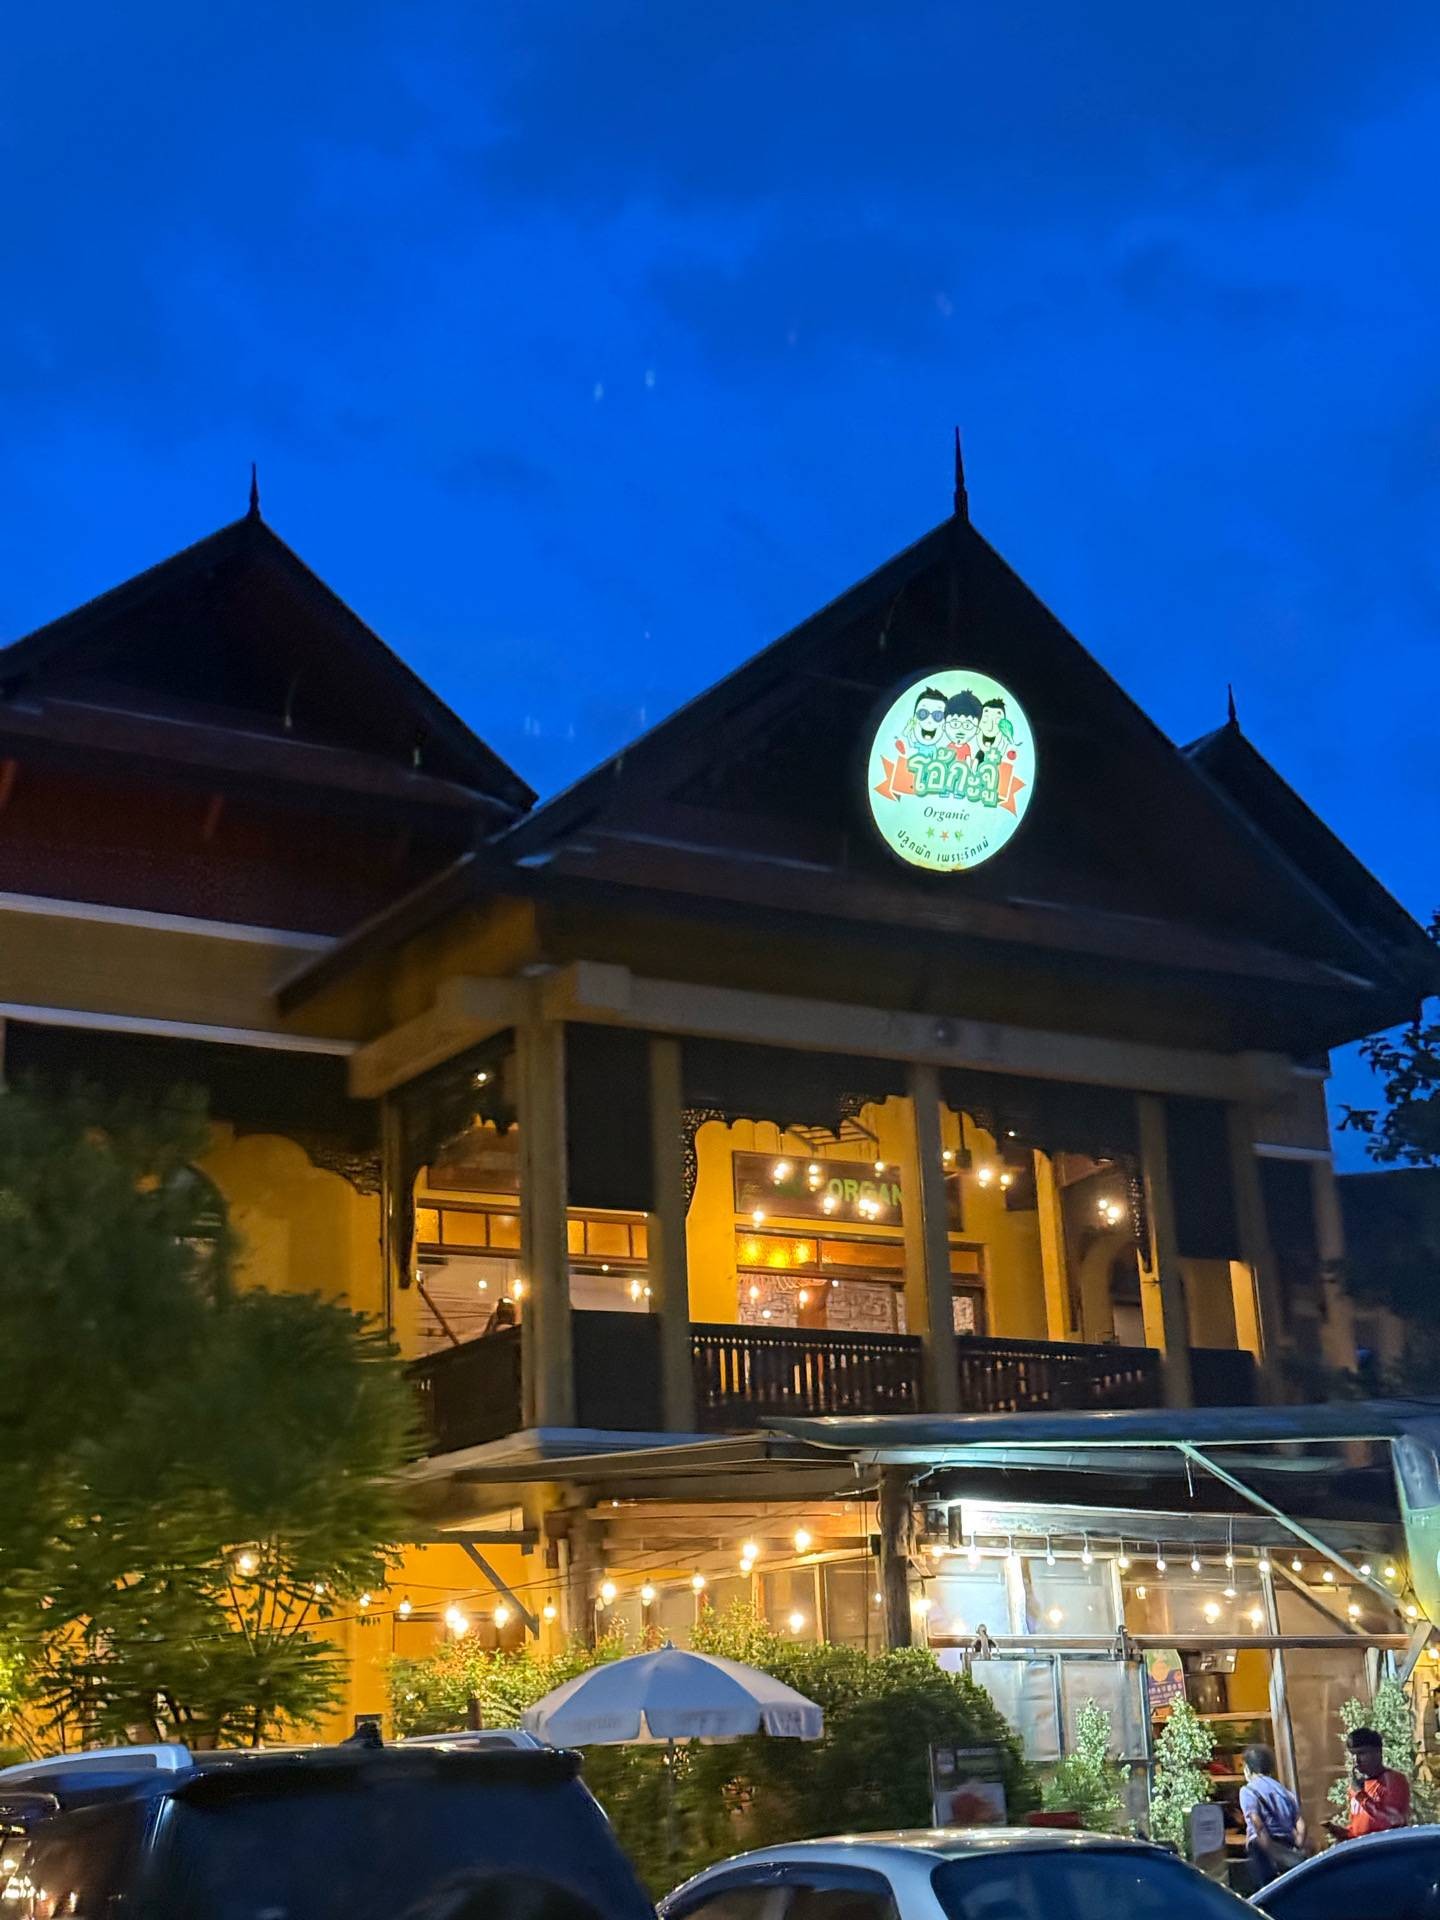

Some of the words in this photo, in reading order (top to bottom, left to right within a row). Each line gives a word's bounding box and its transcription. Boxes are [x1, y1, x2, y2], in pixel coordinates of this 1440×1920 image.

[908, 748, 999, 807] โอ้กะจู๋
[924, 806, 970, 821] Organic
